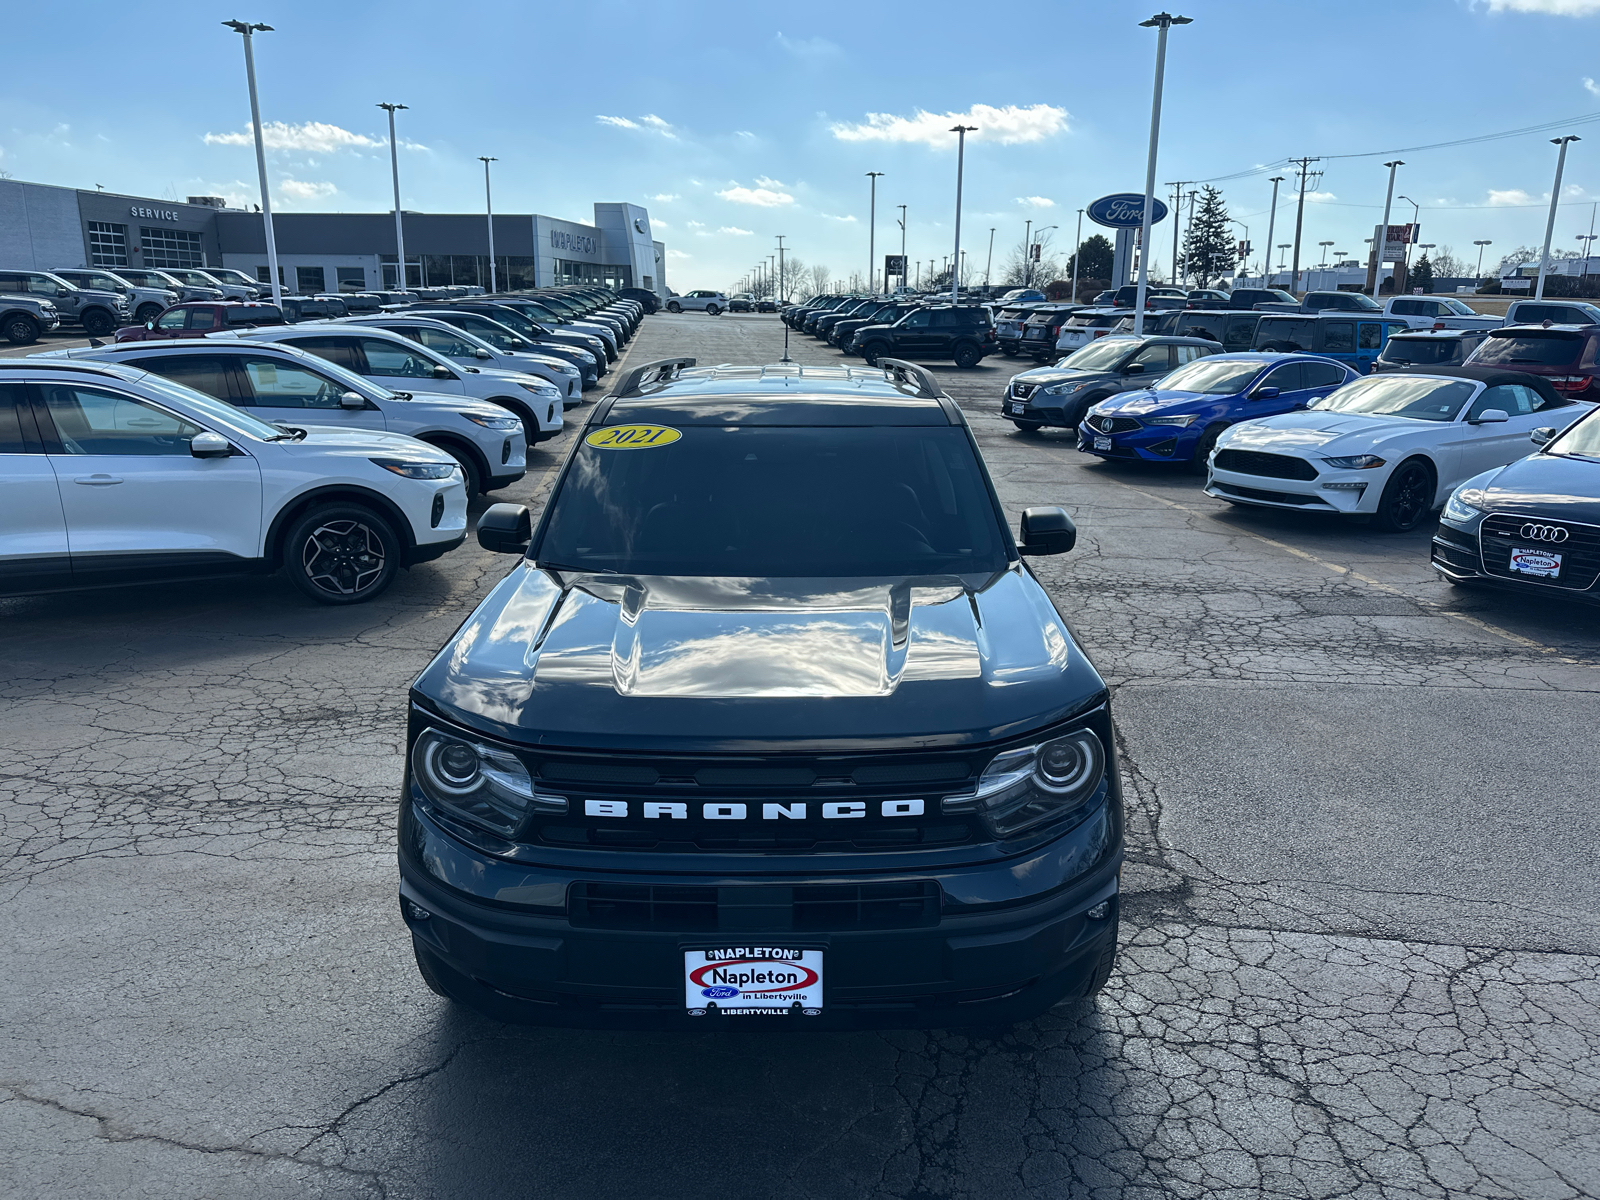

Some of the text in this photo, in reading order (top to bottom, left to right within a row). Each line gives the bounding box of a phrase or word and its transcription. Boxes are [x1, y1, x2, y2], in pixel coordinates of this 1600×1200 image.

[131, 206, 179, 221] SERVICE
[551, 229, 597, 254] NAPLETON
[598, 429, 667, 445] 2021
[1522, 549, 1552, 557] NAPLETON
[1520, 557, 1552, 566] Napleton
[584, 799, 925, 820] BRONCO
[714, 947, 794, 960] NAPLETON
[712, 968, 798, 988] Napleton
[709, 987, 732, 997] Ford
[754, 993, 808, 1002] Libertyville
